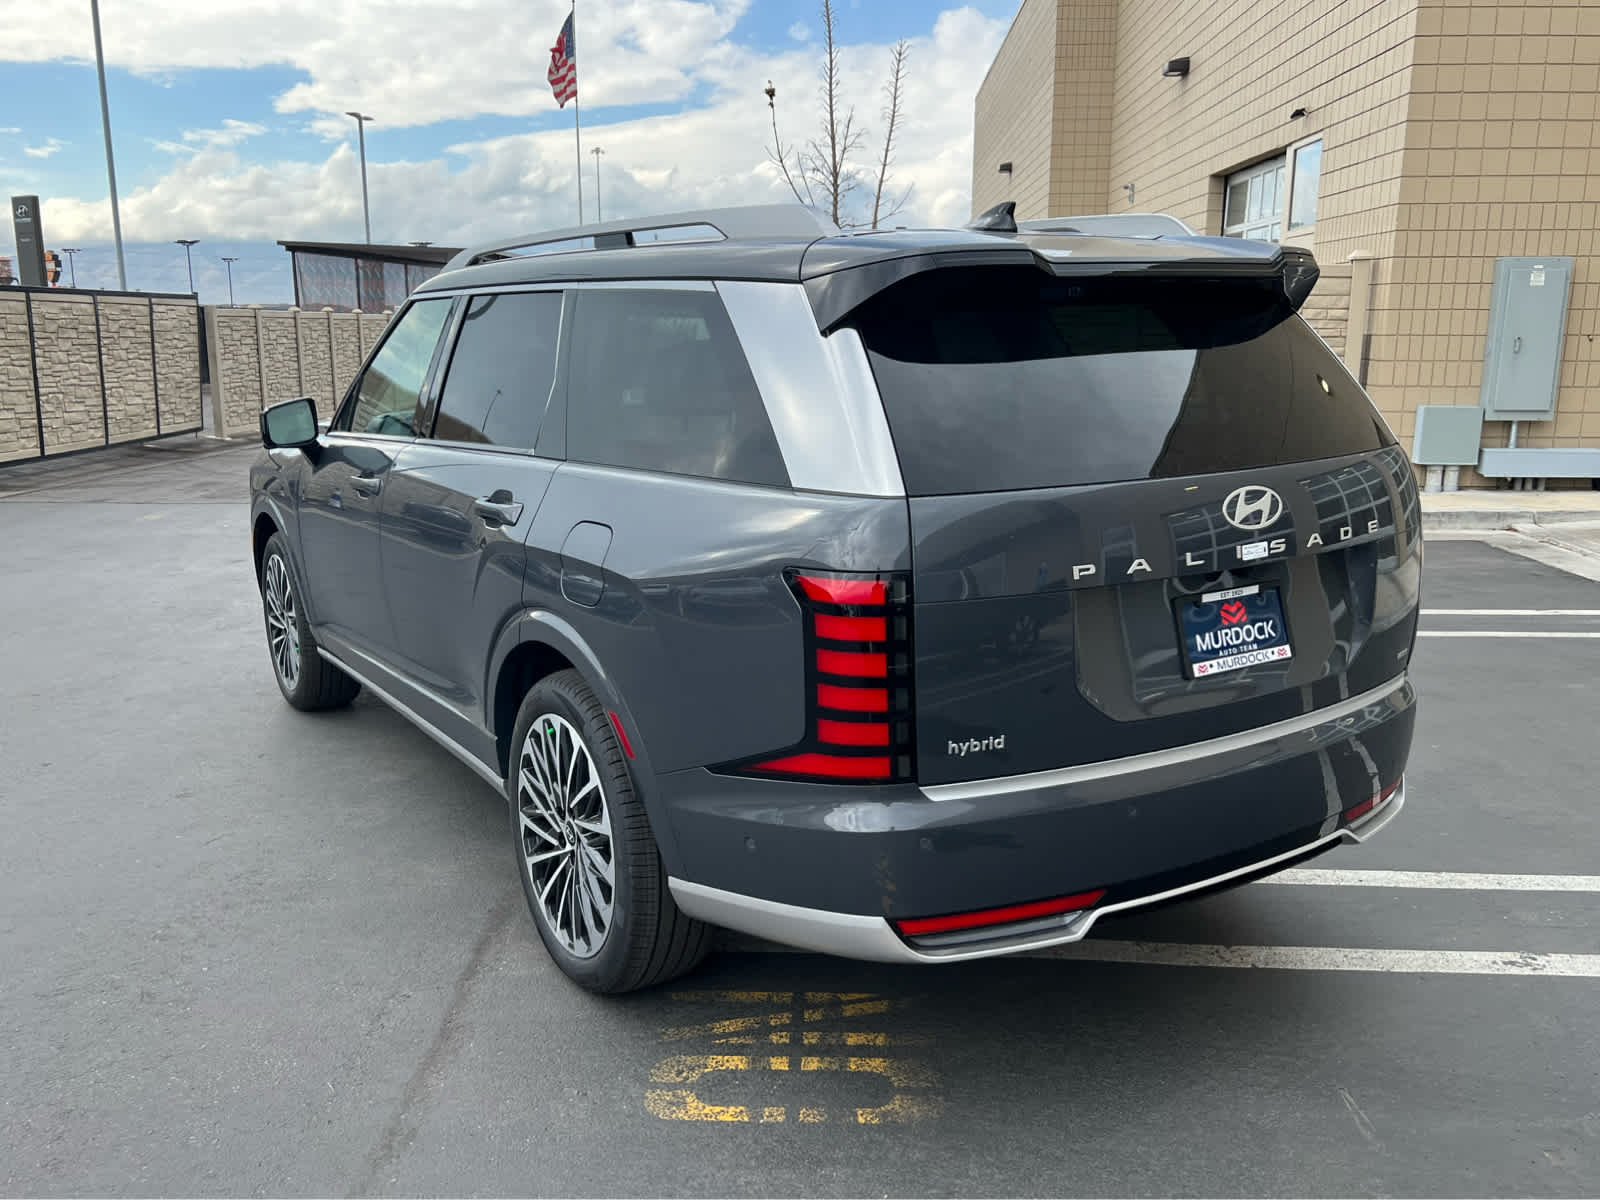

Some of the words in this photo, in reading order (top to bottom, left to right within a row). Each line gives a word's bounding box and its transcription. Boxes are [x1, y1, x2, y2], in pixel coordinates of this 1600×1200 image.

[1072, 519, 1380, 580] PALISADE
[1195, 619, 1276, 652] MURDOCK
[1216, 650, 1270, 670] MURDOCK
[1219, 647, 1238, 657] AUTO
[1239, 642, 1258, 653] TEAM
[947, 734, 1006, 757] hybrid
